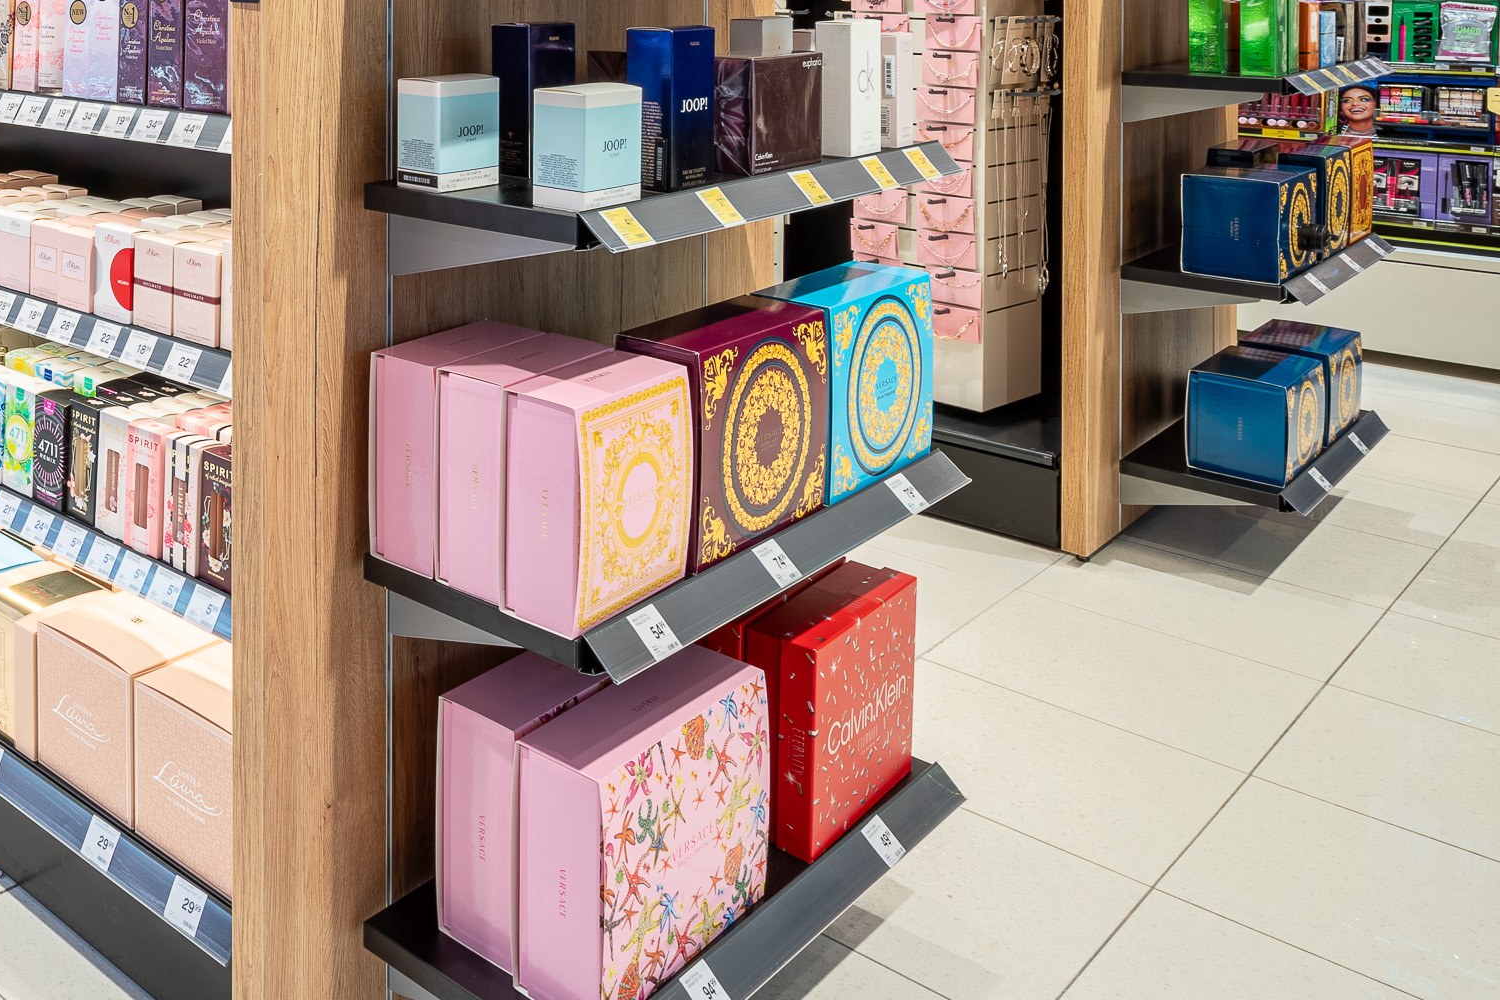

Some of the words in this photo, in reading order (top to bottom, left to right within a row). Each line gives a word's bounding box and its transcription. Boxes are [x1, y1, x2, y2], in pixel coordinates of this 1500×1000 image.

[193, 11, 221, 23] Christina
[153, 20, 175, 31] Christina
[193, 24, 221, 37] Aguilera
[124, 37, 141, 45] Christina
[153, 33, 175, 44] Aguilera
[802, 57, 822, 68] euphoria
[680, 98, 708, 113] JOOP!
[457, 124, 484, 138] JOOP!
[602, 138, 627, 153] JOOP!
[142, 281, 162, 290] SOULMATE
[183, 292, 204, 301] SOULMATE
[876, 375, 898, 389] VERSACE
[72, 408, 96, 426] SPIRIT
[8, 427, 29, 444] 4711
[128, 434, 159, 453] SPIRIT
[38, 438, 58, 457] 4711
[39, 454, 57, 465] REMIX
[203, 459, 232, 480] SPIRIT
[52, 693, 110, 743] Laura
[828, 701, 876, 755] Calvin
[875, 674, 907, 717] Klein
[857, 726, 879, 752] ETERNITY
[792, 727, 805, 776] ETERNITY
[152, 759, 223, 817] Laura
[478, 815, 486, 861] VERSACE
[671, 821, 715, 862] VERSACE
[558, 869, 567, 918] VERSACE
